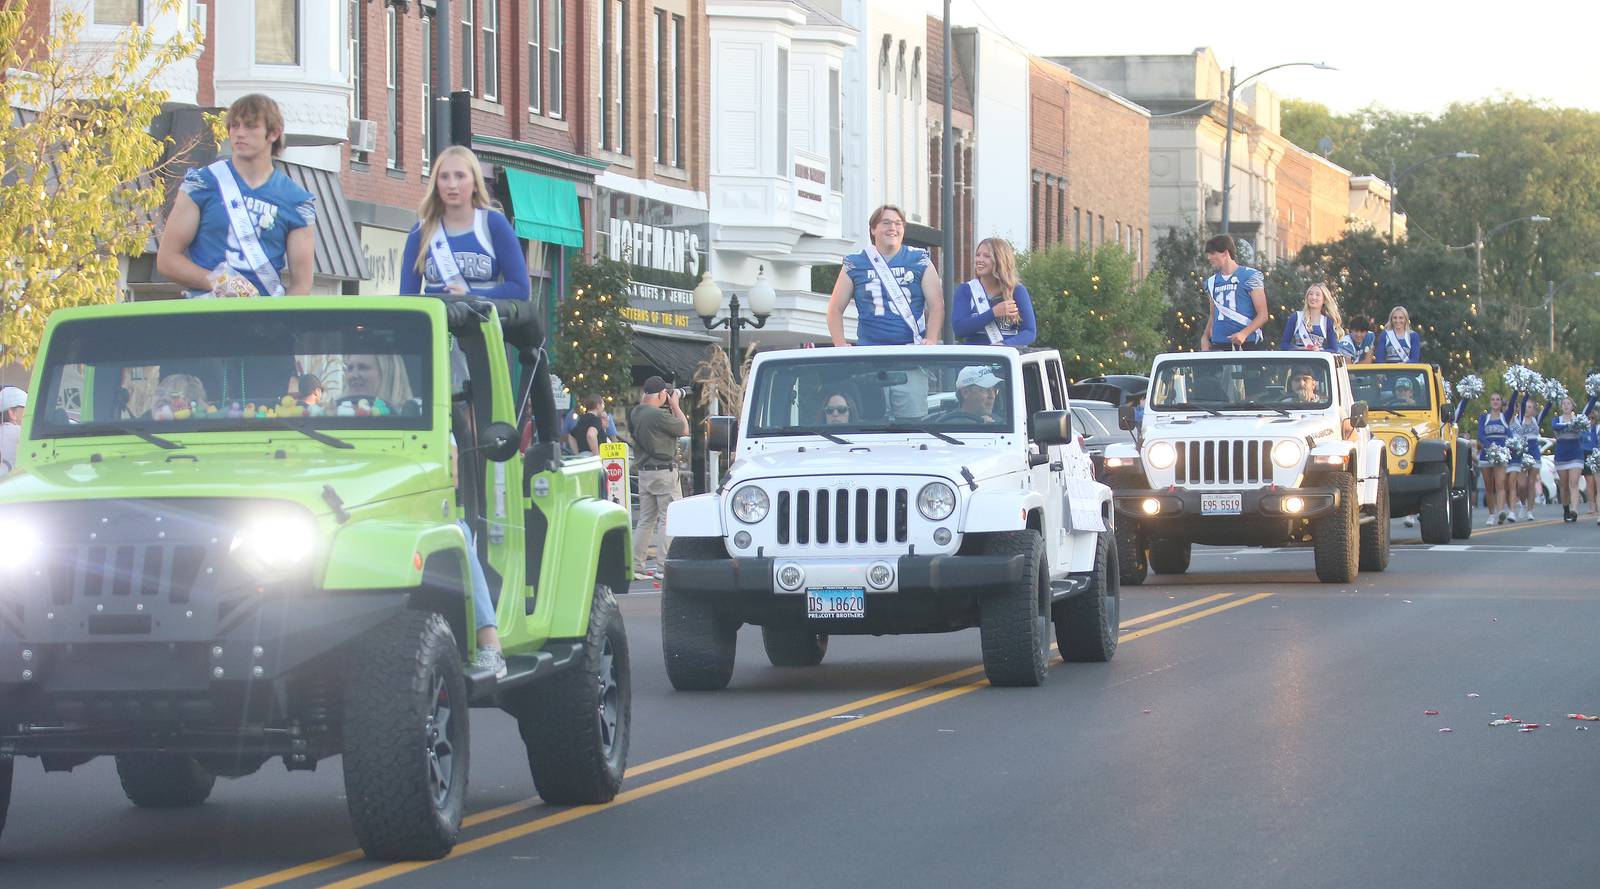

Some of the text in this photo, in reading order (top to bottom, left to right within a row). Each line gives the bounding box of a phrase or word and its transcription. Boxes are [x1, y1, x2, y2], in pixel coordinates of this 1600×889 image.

[610, 217, 699, 277] HOFFMAN'S
[640, 285, 694, 305] GIFTS JEWELR
[1215, 290, 1237, 320] 11
[651, 311, 659, 324] OF
[661, 312, 673, 325] THE
[674, 314, 689, 328] PAST
[1203, 499, 1240, 511] E95 5519
[808, 596, 864, 611] DS 18620
